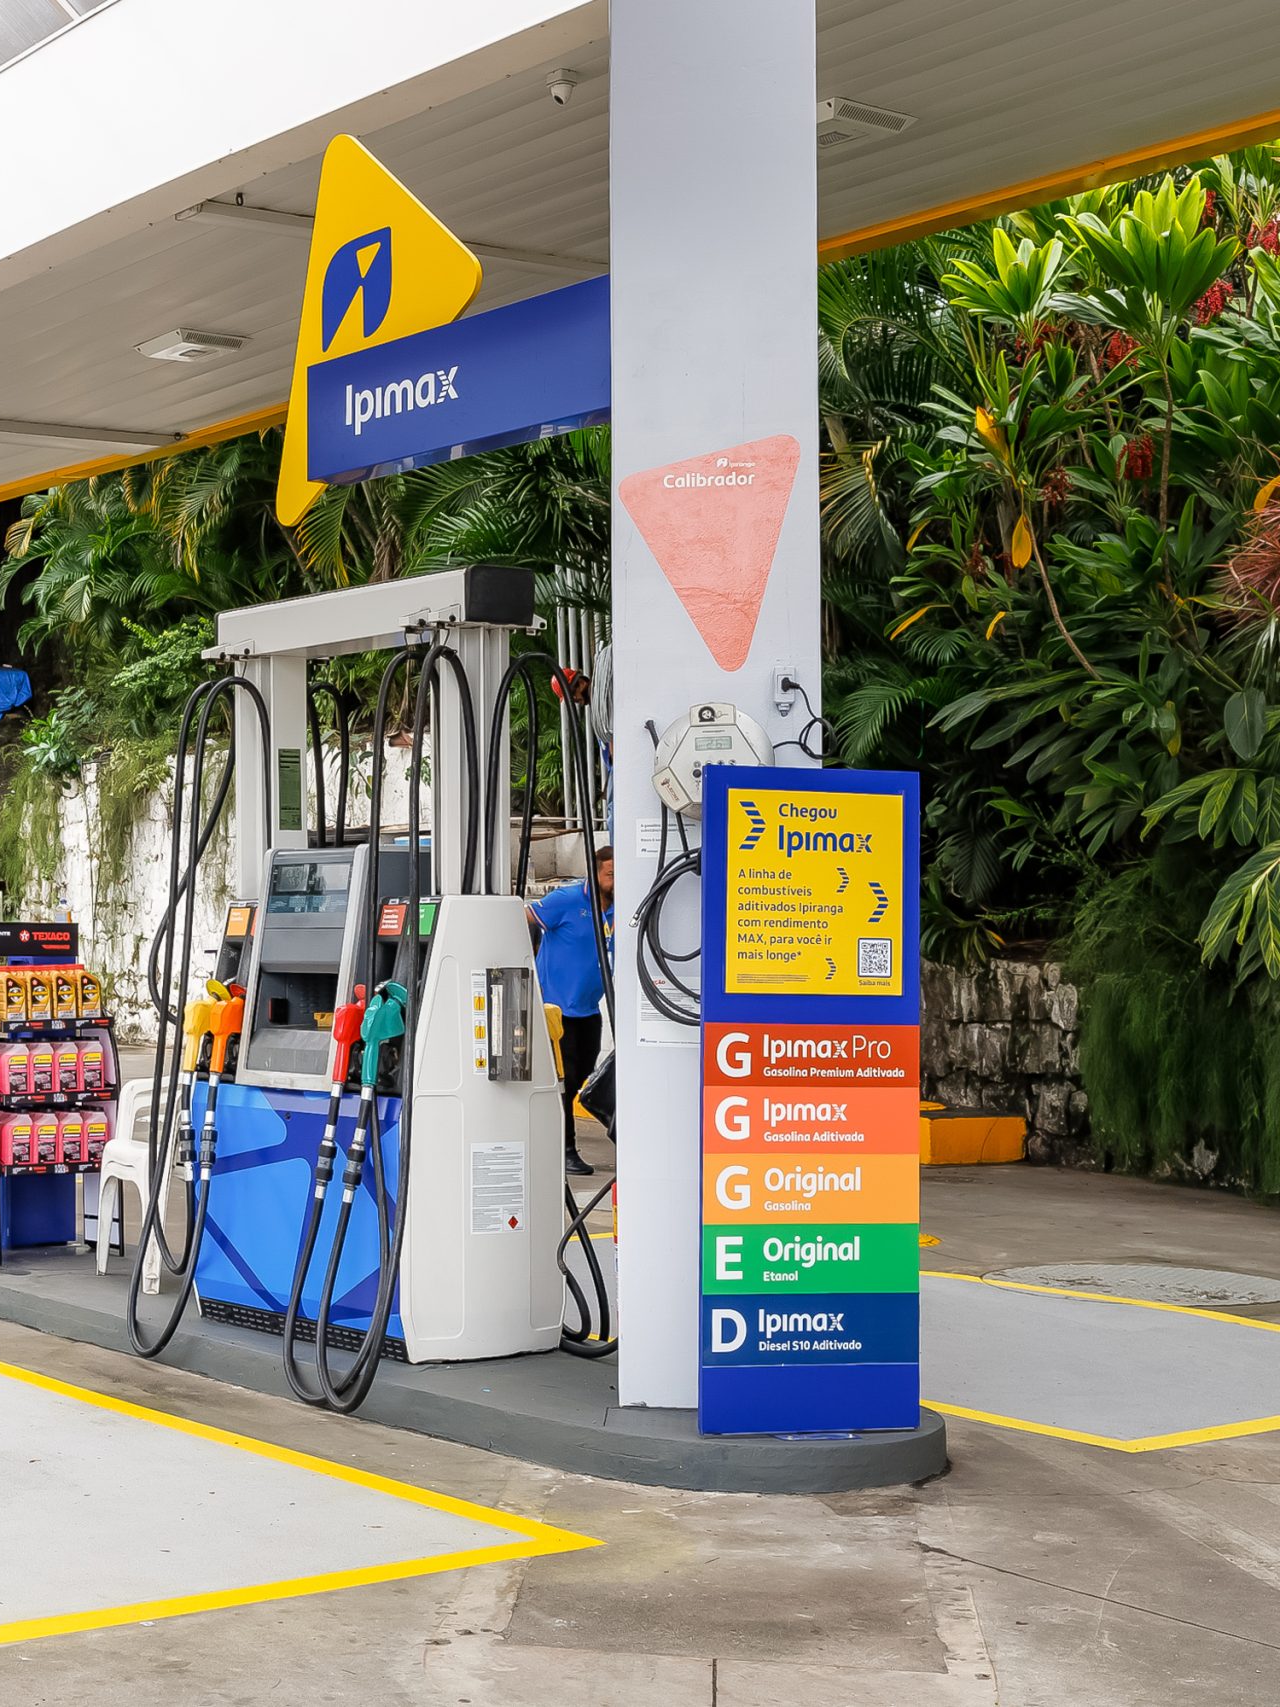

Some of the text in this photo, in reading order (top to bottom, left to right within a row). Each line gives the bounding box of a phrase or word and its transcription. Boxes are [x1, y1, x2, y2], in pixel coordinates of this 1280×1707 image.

[345, 365, 459, 436] Ipimax
[663, 472, 755, 488] Calibrador
[778, 803, 838, 822] Chegou
[778, 825, 873, 858] Ipimax
[738, 868, 792, 879] A linha de
[738, 885, 812, 896] combustíveis
[738, 901, 843, 915] aditivados Ipiranga
[738, 918, 828, 928] com rendimento
[32, 932, 70, 940] TEXACO
[737, 933, 832, 945] MAX, para você ir
[737, 949, 763, 959] mais
[715, 1032, 752, 1078] G
[763, 1034, 891, 1064] Ipimax Pro
[763, 1067, 905, 1078] Gasolina Premium Aditivada
[714, 1095, 751, 1142] G
[763, 1098, 848, 1127] Ipimax
[763, 1131, 864, 1142] Gasolina Aditivada
[715, 1165, 751, 1210] G
[764, 1167, 861, 1198] Original
[764, 1200, 811, 1211] Gasolina
[715, 1236, 743, 1281] E
[763, 1235, 860, 1268] Original
[763, 1270, 798, 1281] Etanol
[711, 1308, 747, 1353] D
[758, 1308, 844, 1339] Ipimax
[758, 1339, 862, 1351] Diesel S10 Aditivado
